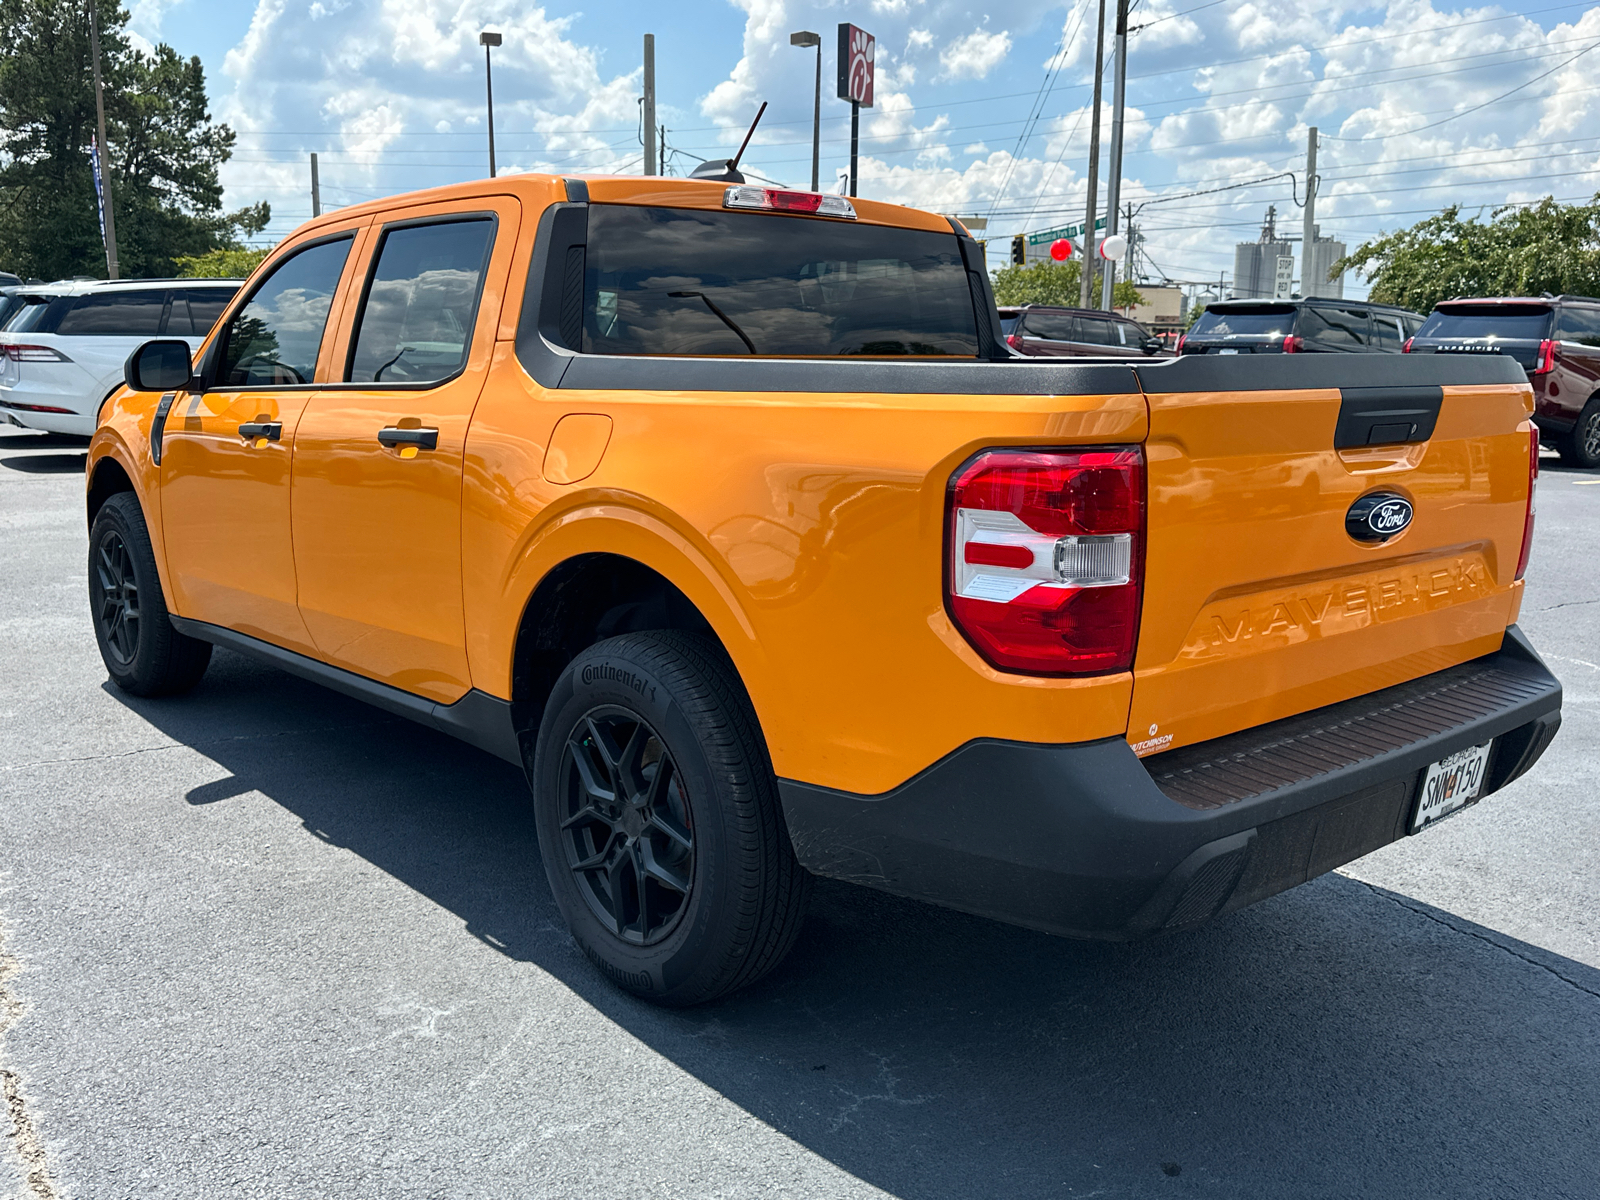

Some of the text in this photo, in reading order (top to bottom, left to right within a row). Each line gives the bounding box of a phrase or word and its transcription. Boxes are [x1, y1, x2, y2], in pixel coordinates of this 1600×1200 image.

[1037, 232, 1057, 243] Industrial
[1057, 229, 1068, 239] Park
[1068, 227, 1076, 236] Rd
[1279, 260, 1291, 269] STOP
[1278, 282, 1288, 292] RED
[1377, 504, 1406, 529] Ford
[1210, 560, 1478, 646] MAVERICK
[581, 662, 649, 697] Continental
